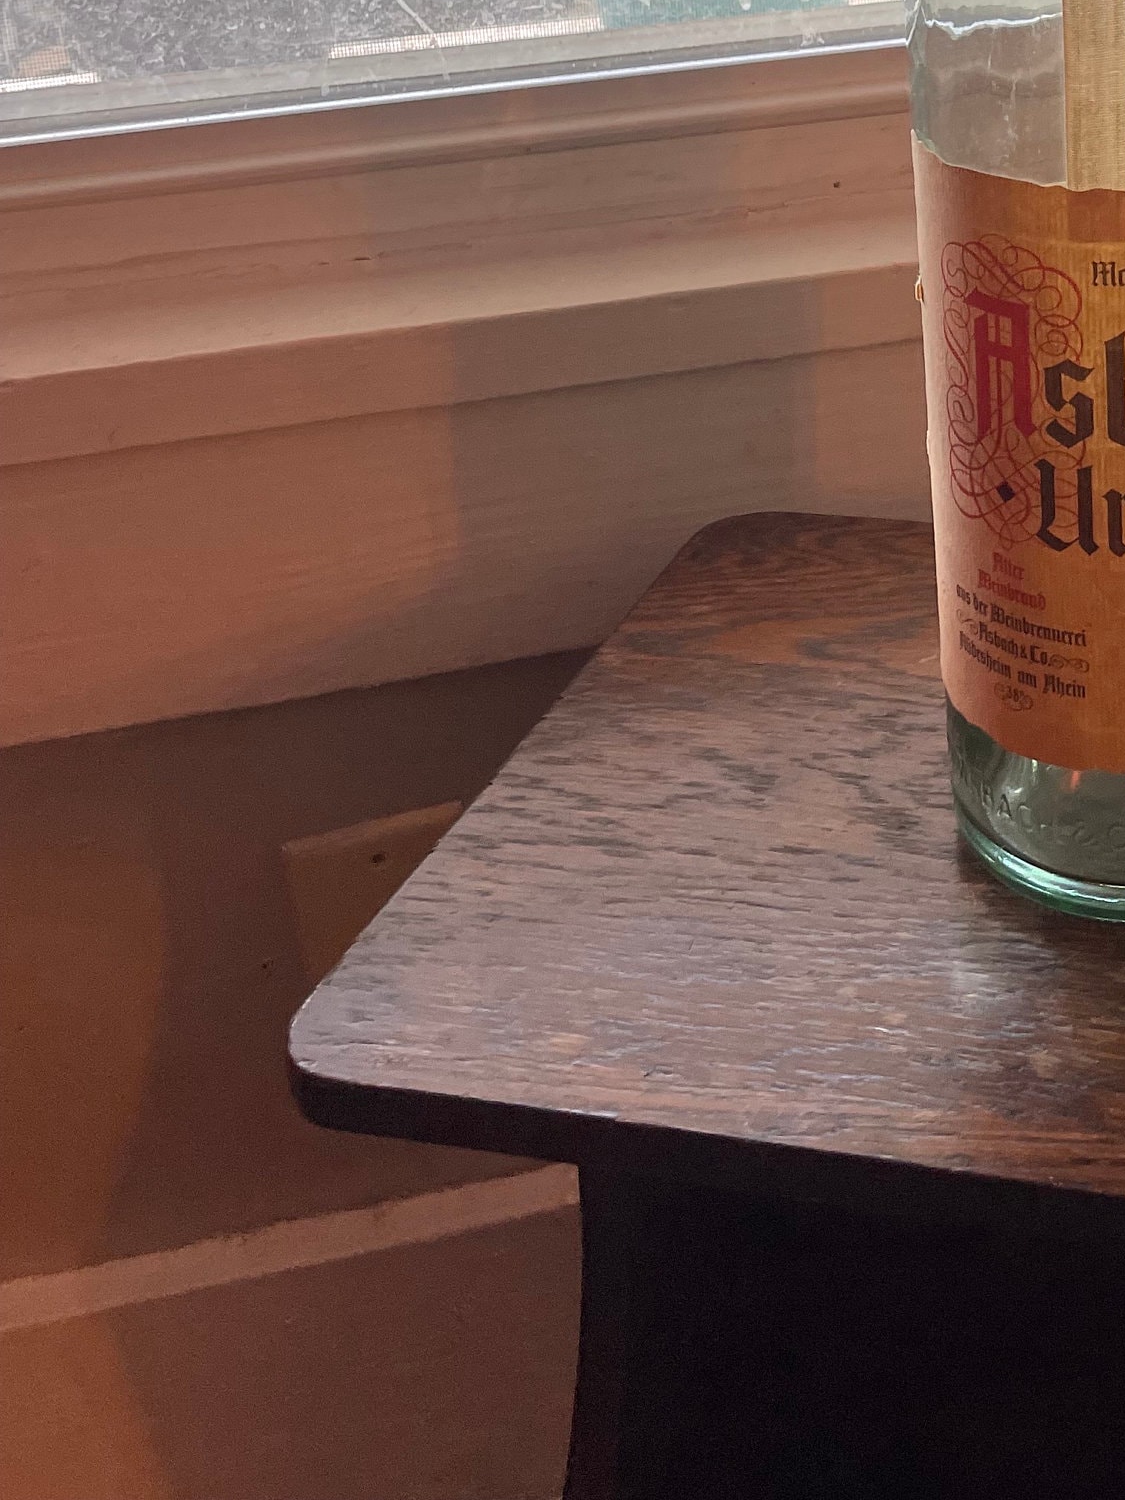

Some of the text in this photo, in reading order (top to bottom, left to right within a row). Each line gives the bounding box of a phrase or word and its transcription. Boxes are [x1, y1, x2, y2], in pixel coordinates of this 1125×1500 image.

[977, 568, 1047, 610] Weinbrand
[972, 592, 988, 617] der
[990, 602, 1087, 647] Weinbrennerei
[978, 621, 1019, 658] Asbach
[1017, 670, 1038, 689] am
[1042, 673, 1087, 699] Rhein
